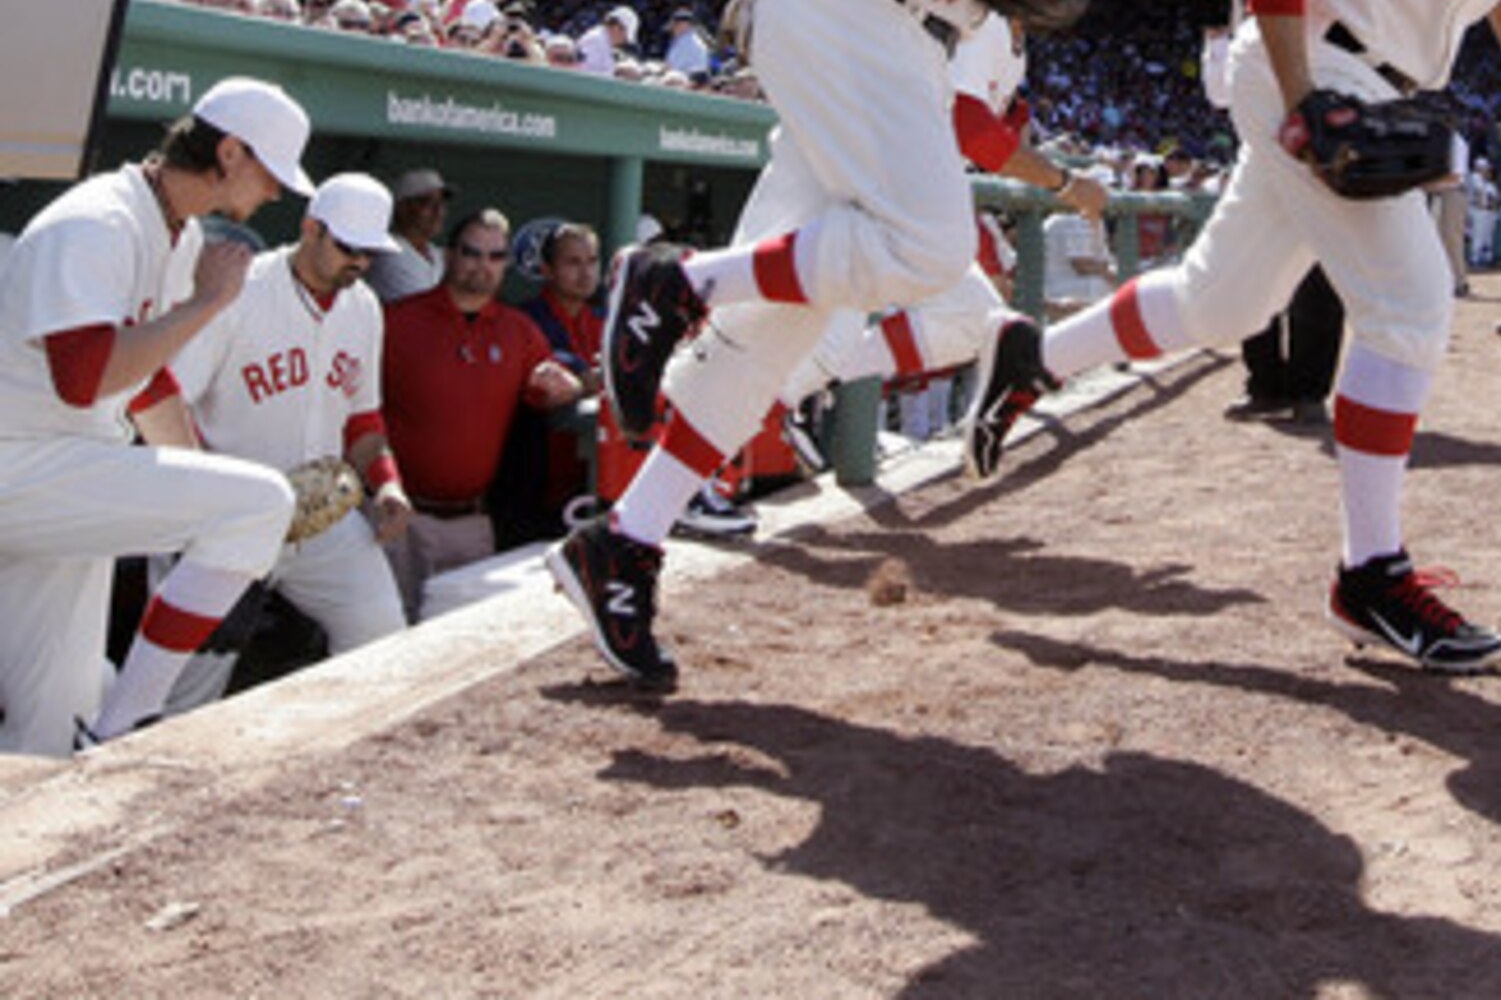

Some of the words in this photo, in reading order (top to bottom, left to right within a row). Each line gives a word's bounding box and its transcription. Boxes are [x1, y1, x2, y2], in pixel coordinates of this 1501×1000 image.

[387, 89, 555, 138] bankofamerica.com
[627, 300, 661, 343] N
[242, 346, 310, 404] RED
[606, 582, 635, 615] N
